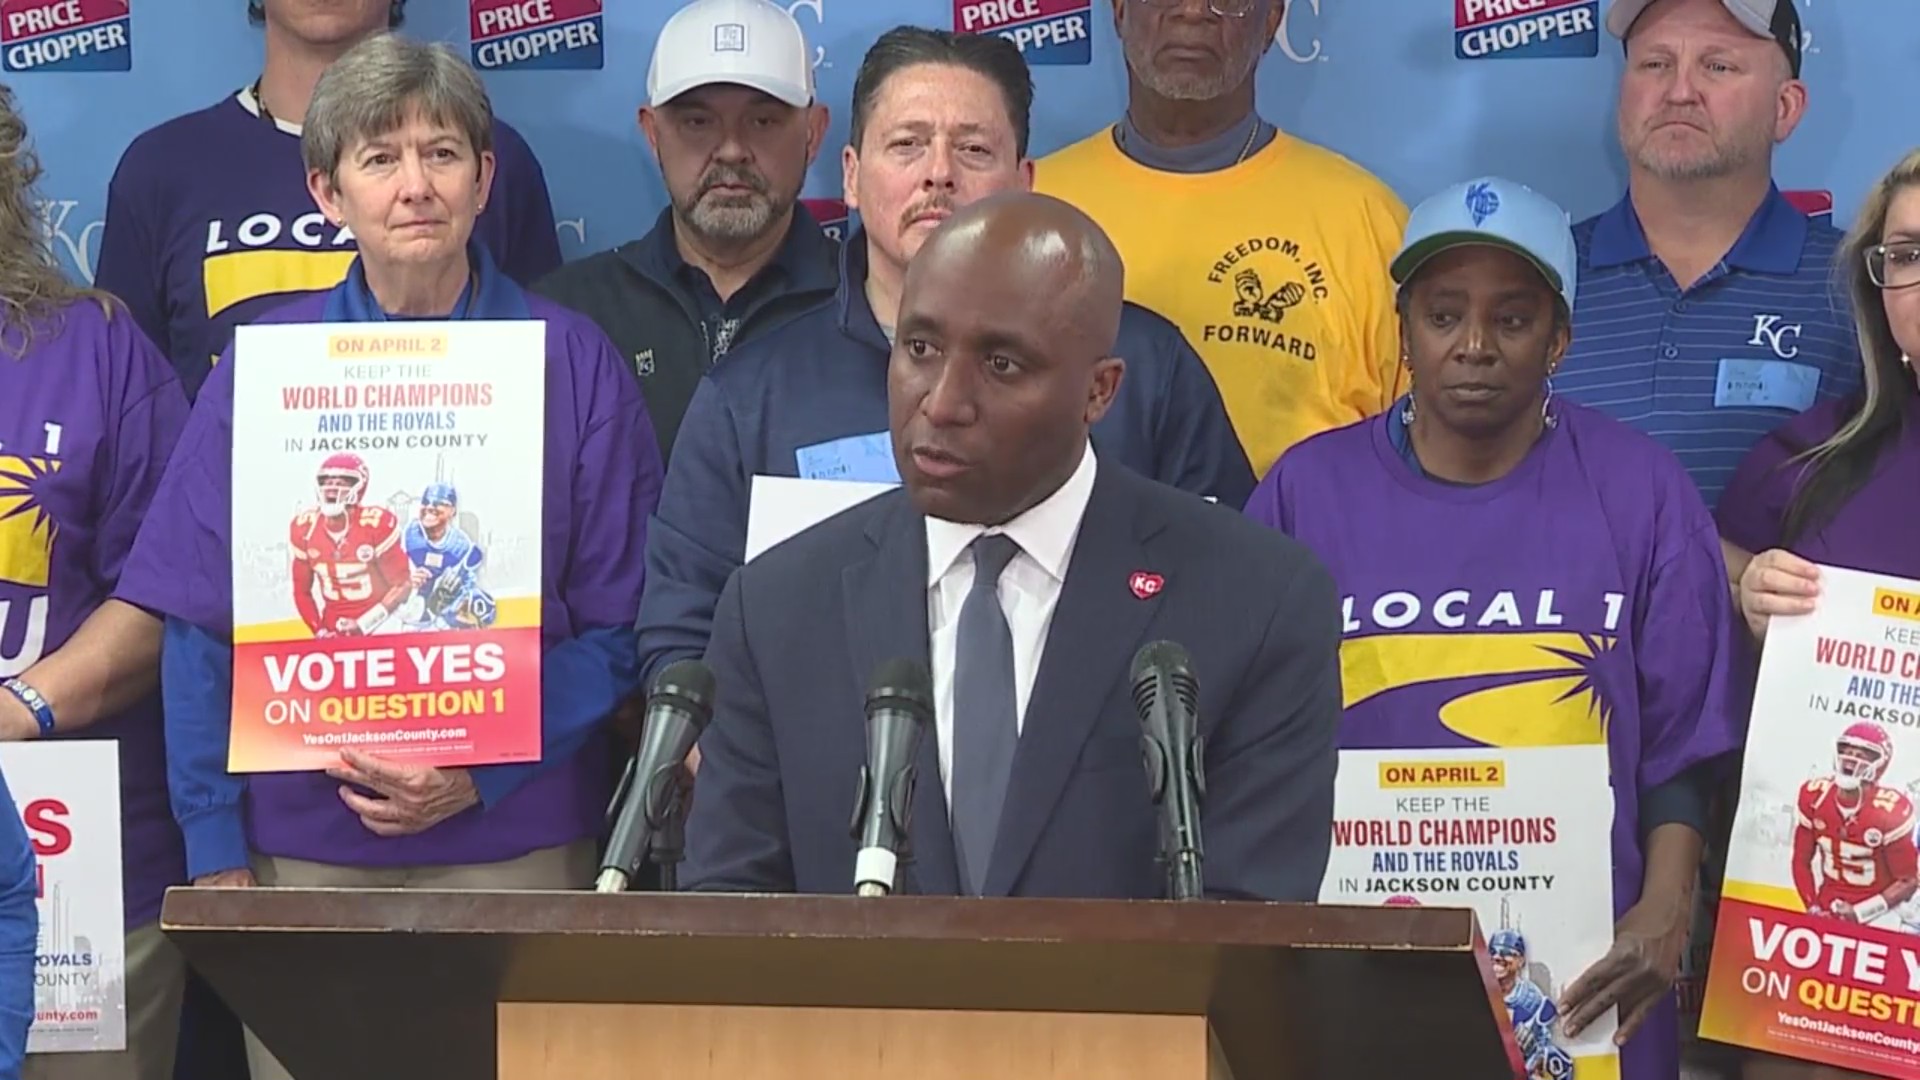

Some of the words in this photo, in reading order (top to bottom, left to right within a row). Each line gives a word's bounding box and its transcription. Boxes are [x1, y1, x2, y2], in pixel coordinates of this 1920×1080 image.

[8, 0, 84, 37] PRICE
[478, 0, 554, 35] PRICE
[962, 0, 1040, 30] PRICE
[1461, 7, 1594, 56] CHOPPER
[8, 23, 127, 70] CHOPPER
[477, 21, 599, 67] CHOPPER
[1207, 237, 1301, 283] FREEDOM,
[1304, 262, 1329, 305] INC.
[336, 339, 364, 353] ON
[369, 338, 423, 352] APRIL
[427, 337, 441, 351] 2
[1203, 325, 1316, 361] FORWARD
[1747, 314, 1801, 358] KC
[344, 365, 390, 379] KEEP
[398, 364, 432, 377] THE
[282, 386, 357, 410] WORLD
[364, 383, 493, 408] CHAMPIONS
[44, 422, 62, 455] 1
[317, 413, 353, 433] AND
[357, 412, 388, 432] THE
[392, 411, 456, 431] ROYALS
[285, 438, 303, 452] IN
[309, 435, 399, 451] JACKSON
[405, 433, 488, 449] COUNTY
[312, 562, 373, 601] 15
[1134, 576, 1158, 593] KC
[1342, 589, 1563, 633] LOCAL
[1603, 592, 1625, 630] 1
[1880, 594, 1910, 613] ON
[264, 648, 396, 693] VOTE
[406, 643, 506, 684] YES
[1816, 637, 1895, 675] WORLD
[1847, 675, 1885, 700] AND
[264, 698, 311, 724] ON
[319, 690, 485, 725] QUESTION
[492, 688, 505, 713] 1
[1809, 694, 1830, 711] IN
[1834, 700, 1920, 728] JACKSO
[1386, 768, 1416, 783] ON
[1421, 767, 1481, 782] APRIL
[1486, 766, 1499, 781] 2
[1396, 797, 1445, 813] KEEP
[1453, 796, 1490, 812] THE
[1333, 820, 1411, 846] WORLD
[1419, 817, 1557, 845] CHAMPIONS
[1372, 852, 1408, 873] AND
[1413, 851, 1446, 872] THE
[1451, 850, 1519, 871] ROYALS
[1816, 835, 1875, 886] 15
[1339, 878, 1358, 892] IN
[1364, 877, 1460, 893] JACKSON
[1466, 875, 1555, 892] COUNTY
[36, 954, 92, 967] OYALS
[1748, 917, 1888, 985] VOTE
[1742, 966, 1791, 1000] ON
[35, 1010, 98, 1025] unty.com
